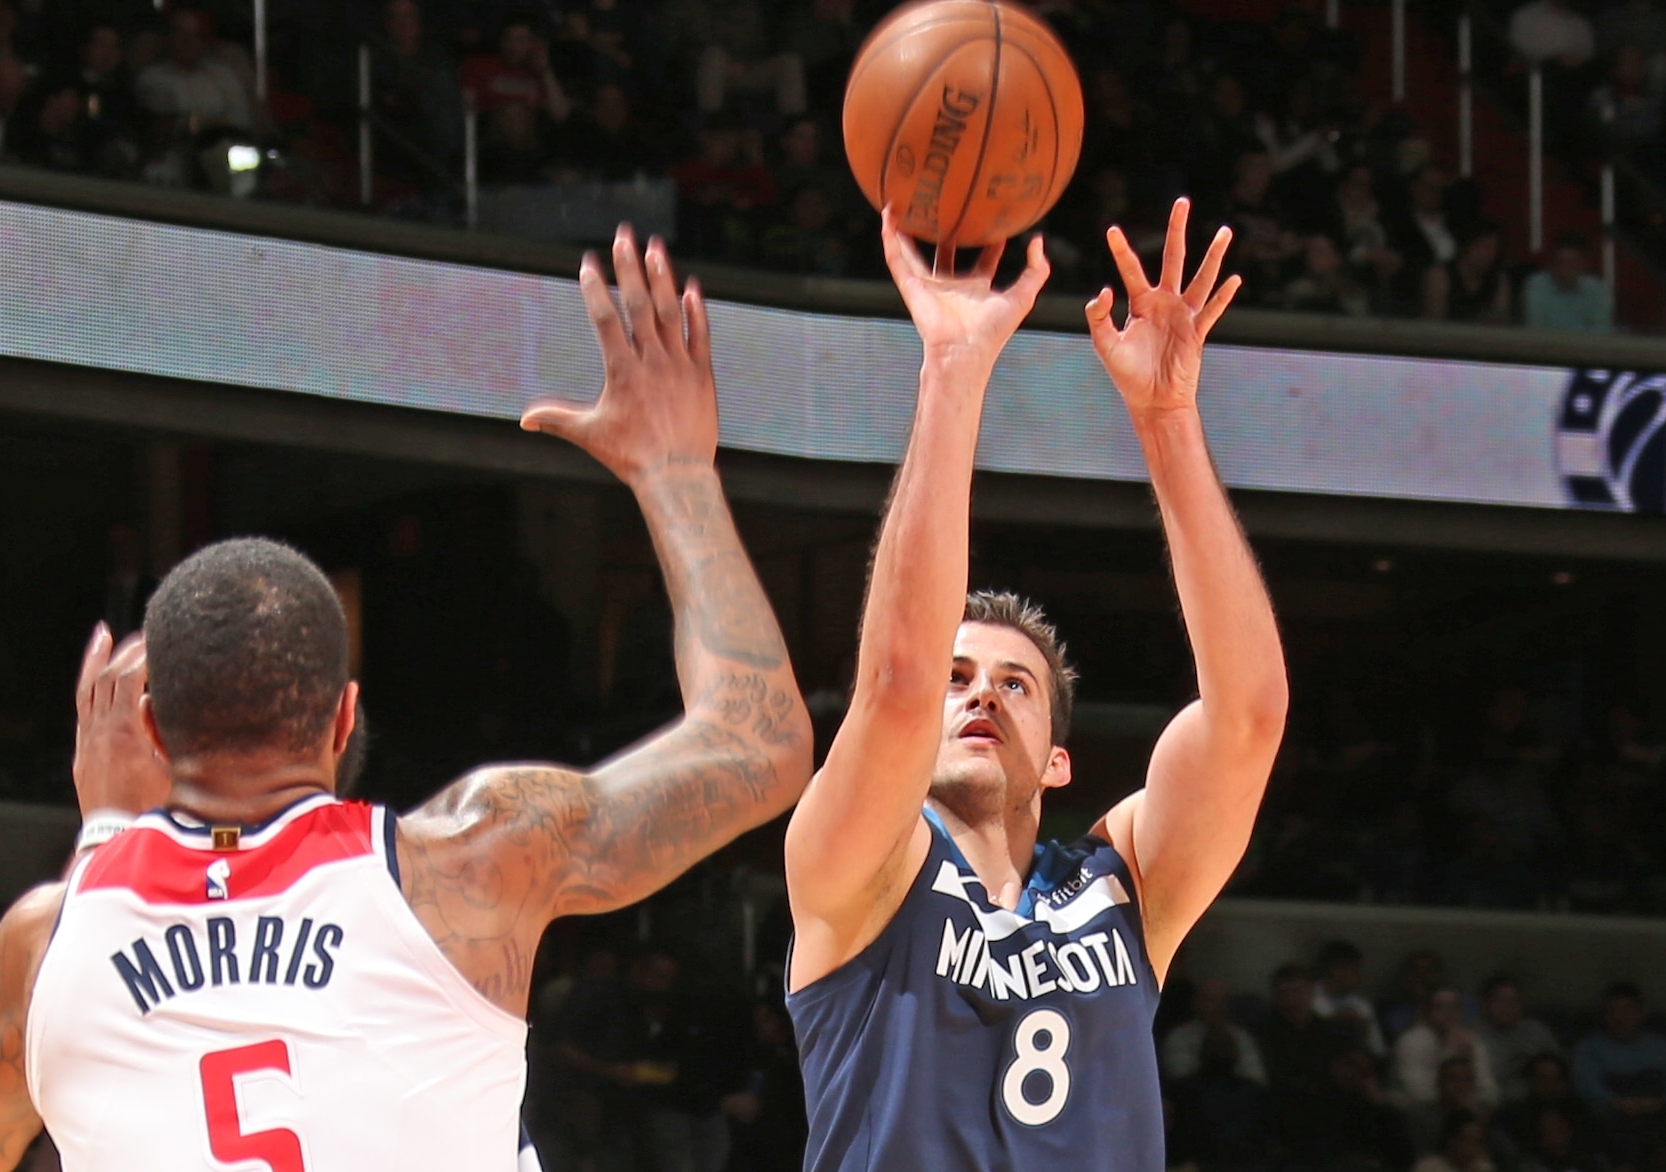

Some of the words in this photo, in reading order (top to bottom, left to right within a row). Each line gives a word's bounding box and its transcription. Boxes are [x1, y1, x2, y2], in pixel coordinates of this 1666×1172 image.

[1051, 867, 1093, 905] fitbit
[110, 915, 344, 1016] MORRIS
[1001, 1008, 1071, 1127] 8
